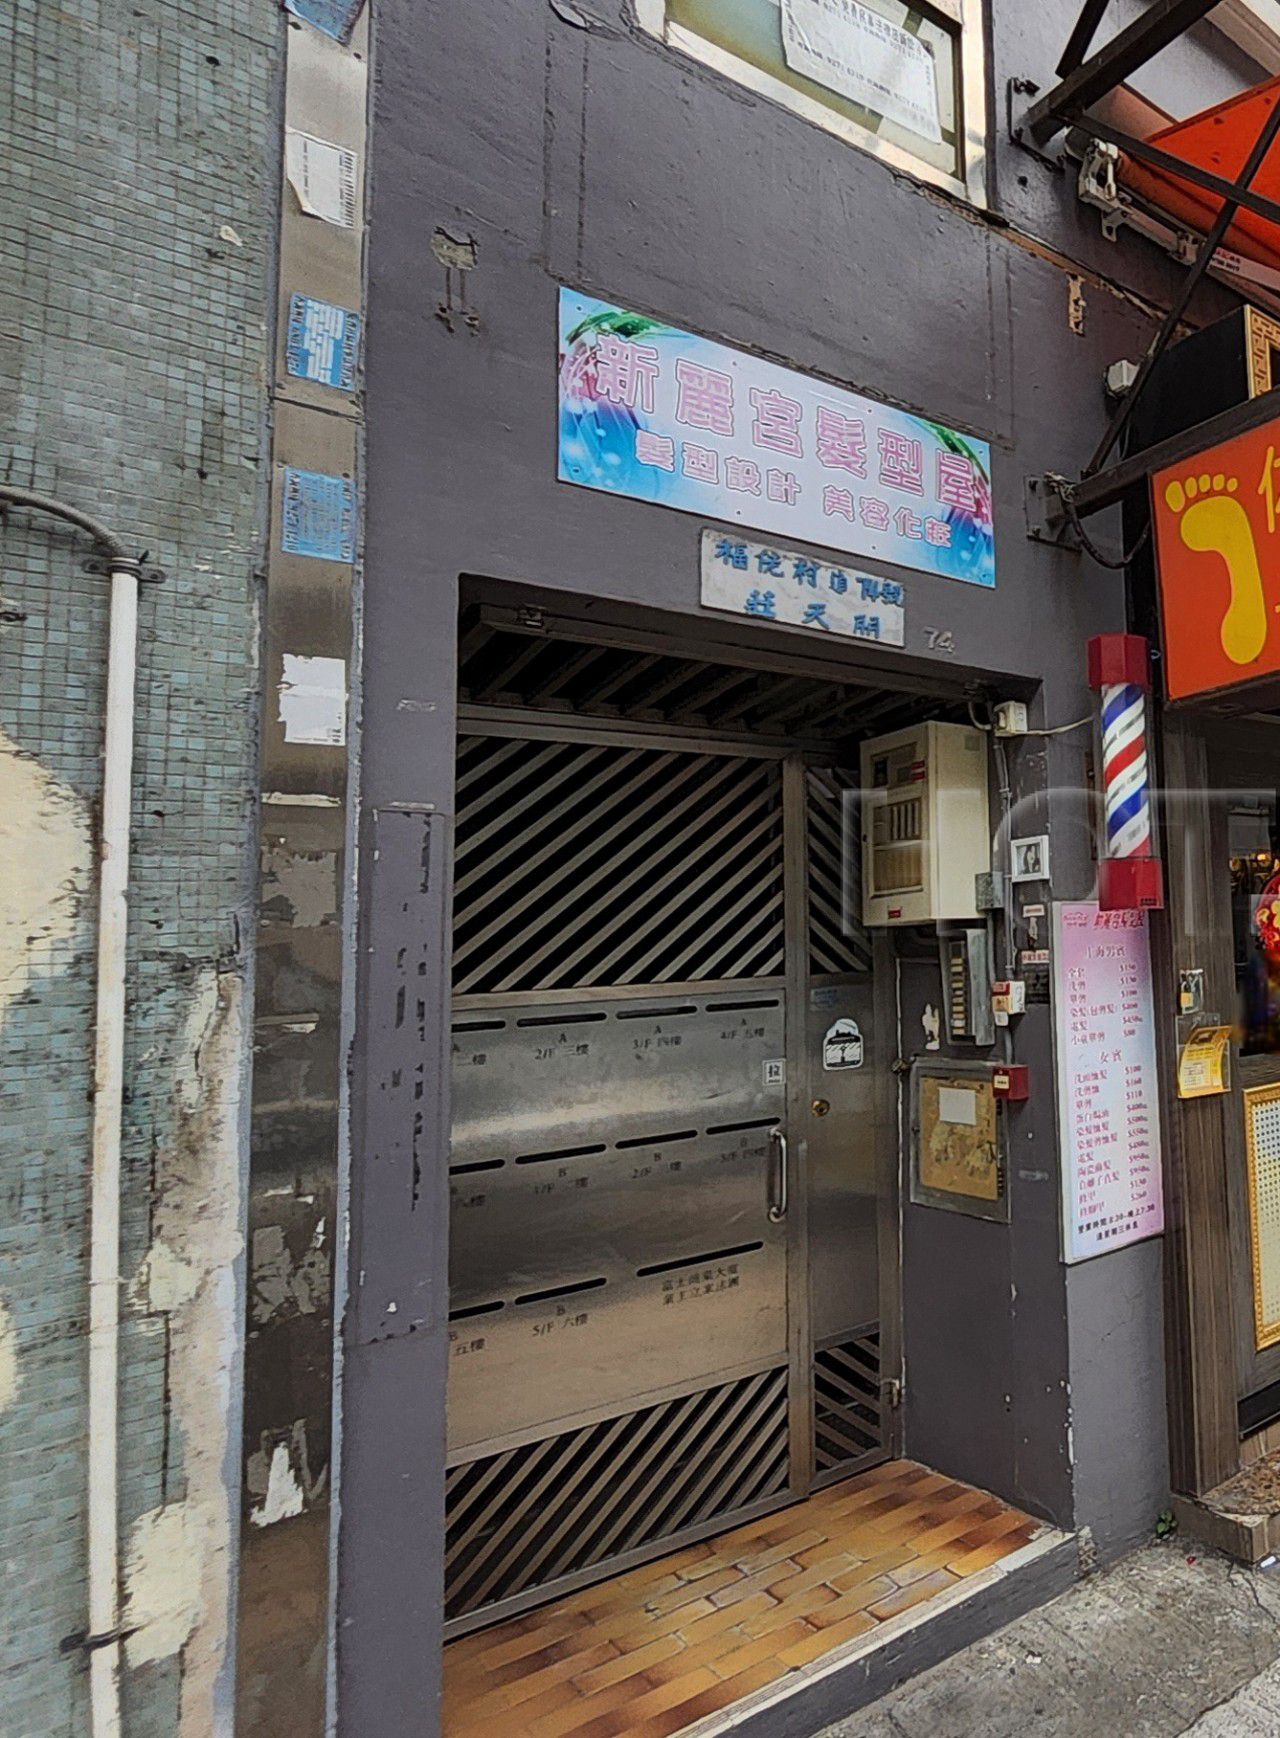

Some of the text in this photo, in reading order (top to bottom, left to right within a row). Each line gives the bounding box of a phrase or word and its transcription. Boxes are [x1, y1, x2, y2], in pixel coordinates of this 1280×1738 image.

[634, 428, 801, 506] 髮型設計
[923, 625, 957, 654] 74
[558, 1032, 568, 1044] A
[534, 1047, 556, 1060] 2/F
